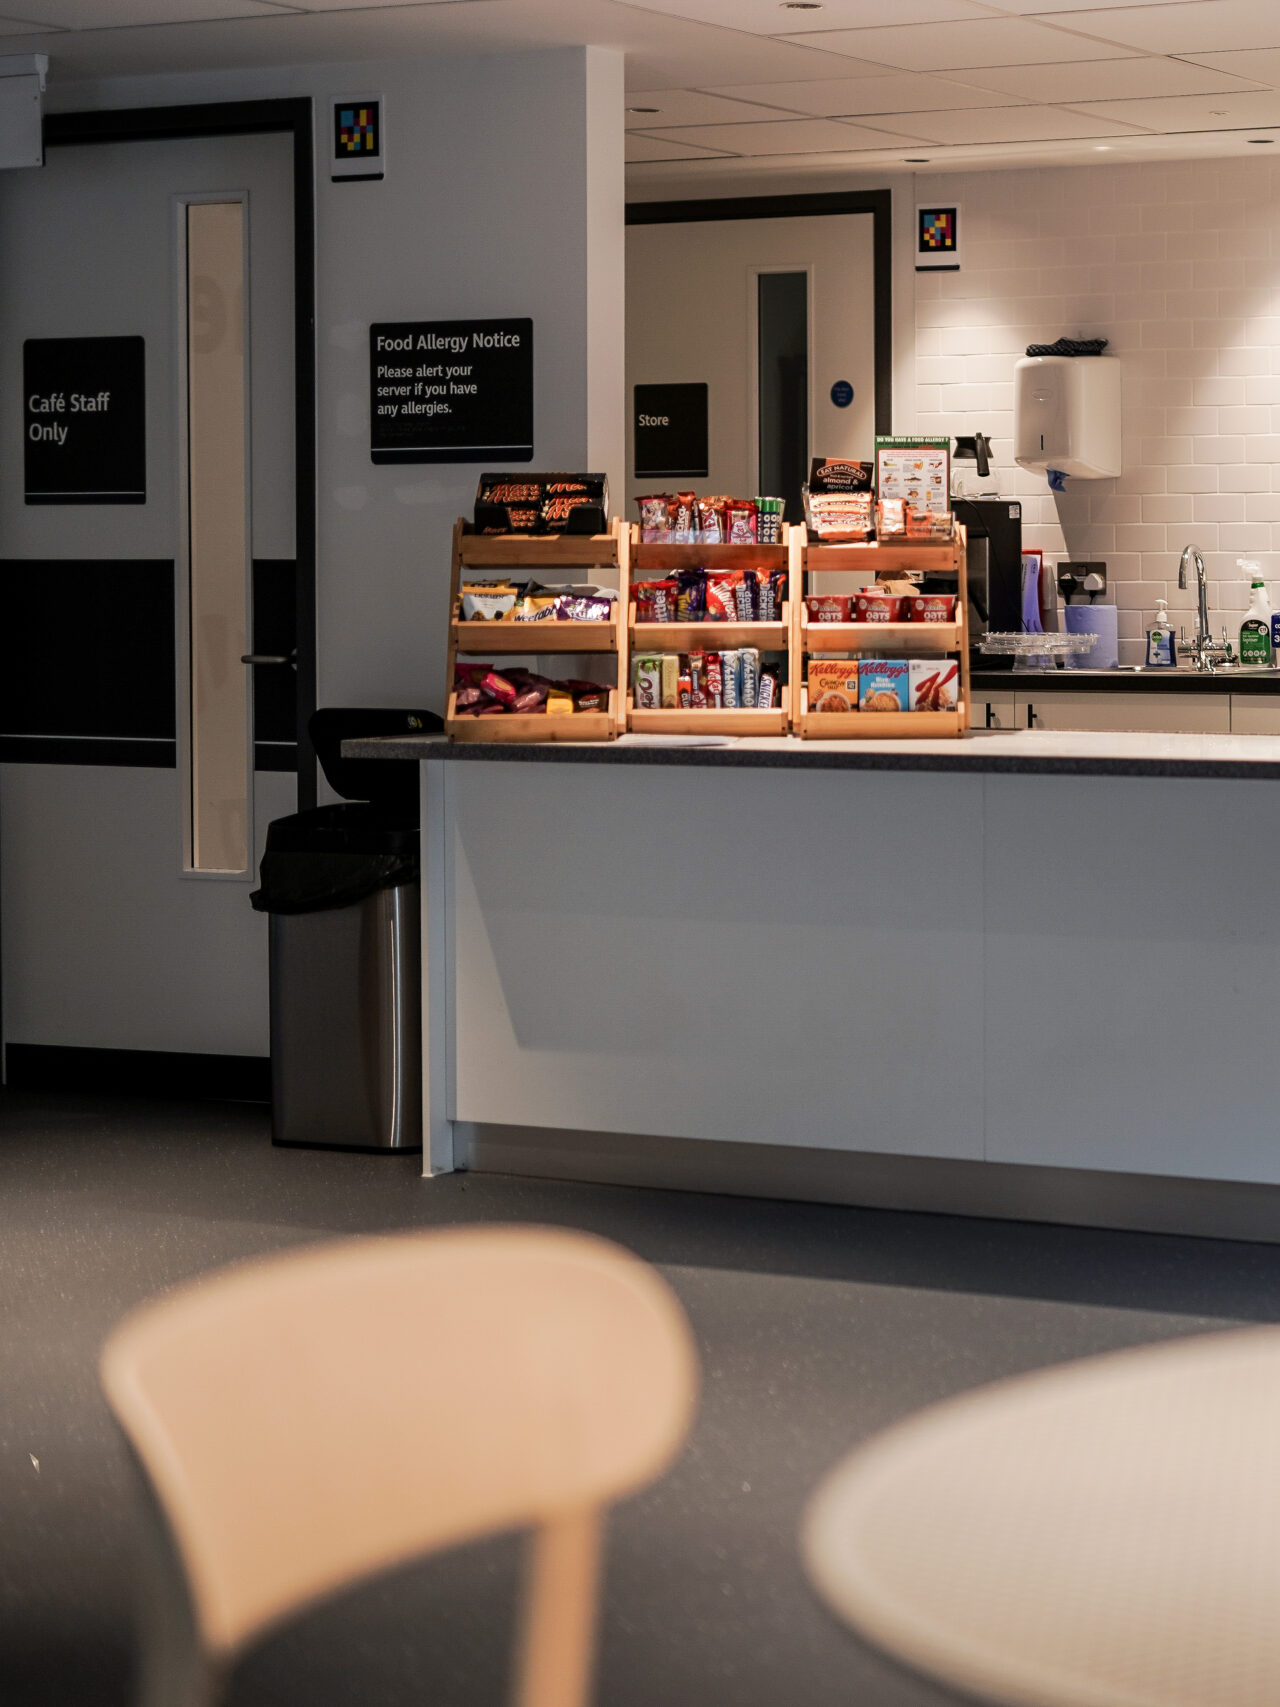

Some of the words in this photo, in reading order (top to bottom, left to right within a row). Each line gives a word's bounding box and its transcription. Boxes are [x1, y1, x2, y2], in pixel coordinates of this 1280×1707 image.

[376, 335, 412, 351] Food
[417, 333, 468, 352] Allergy
[472, 331, 520, 348] Notice
[377, 366, 413, 378] Please
[416, 364, 443, 377] alert
[446, 366, 473, 379] your
[377, 384, 412, 396] server
[414, 383, 423, 395] if
[425, 386, 447, 398] you
[451, 382, 478, 394] have
[29, 393, 65, 413] Café
[70, 392, 110, 412] Staff
[377, 404, 398, 417] any
[401, 402, 452, 417] allergies.
[639, 414, 669, 426] Store
[29, 422, 68, 445] Only
[820, 467, 832, 475] EAT
[833, 465, 864, 478] NATURAL
[763, 514, 771, 543] POLO
[809, 663, 858, 679] Kellogg's
[858, 662, 909, 678] Kellogg's
[723, 664, 736, 707] OUNTY
[743, 663, 755, 706] OUNTY
